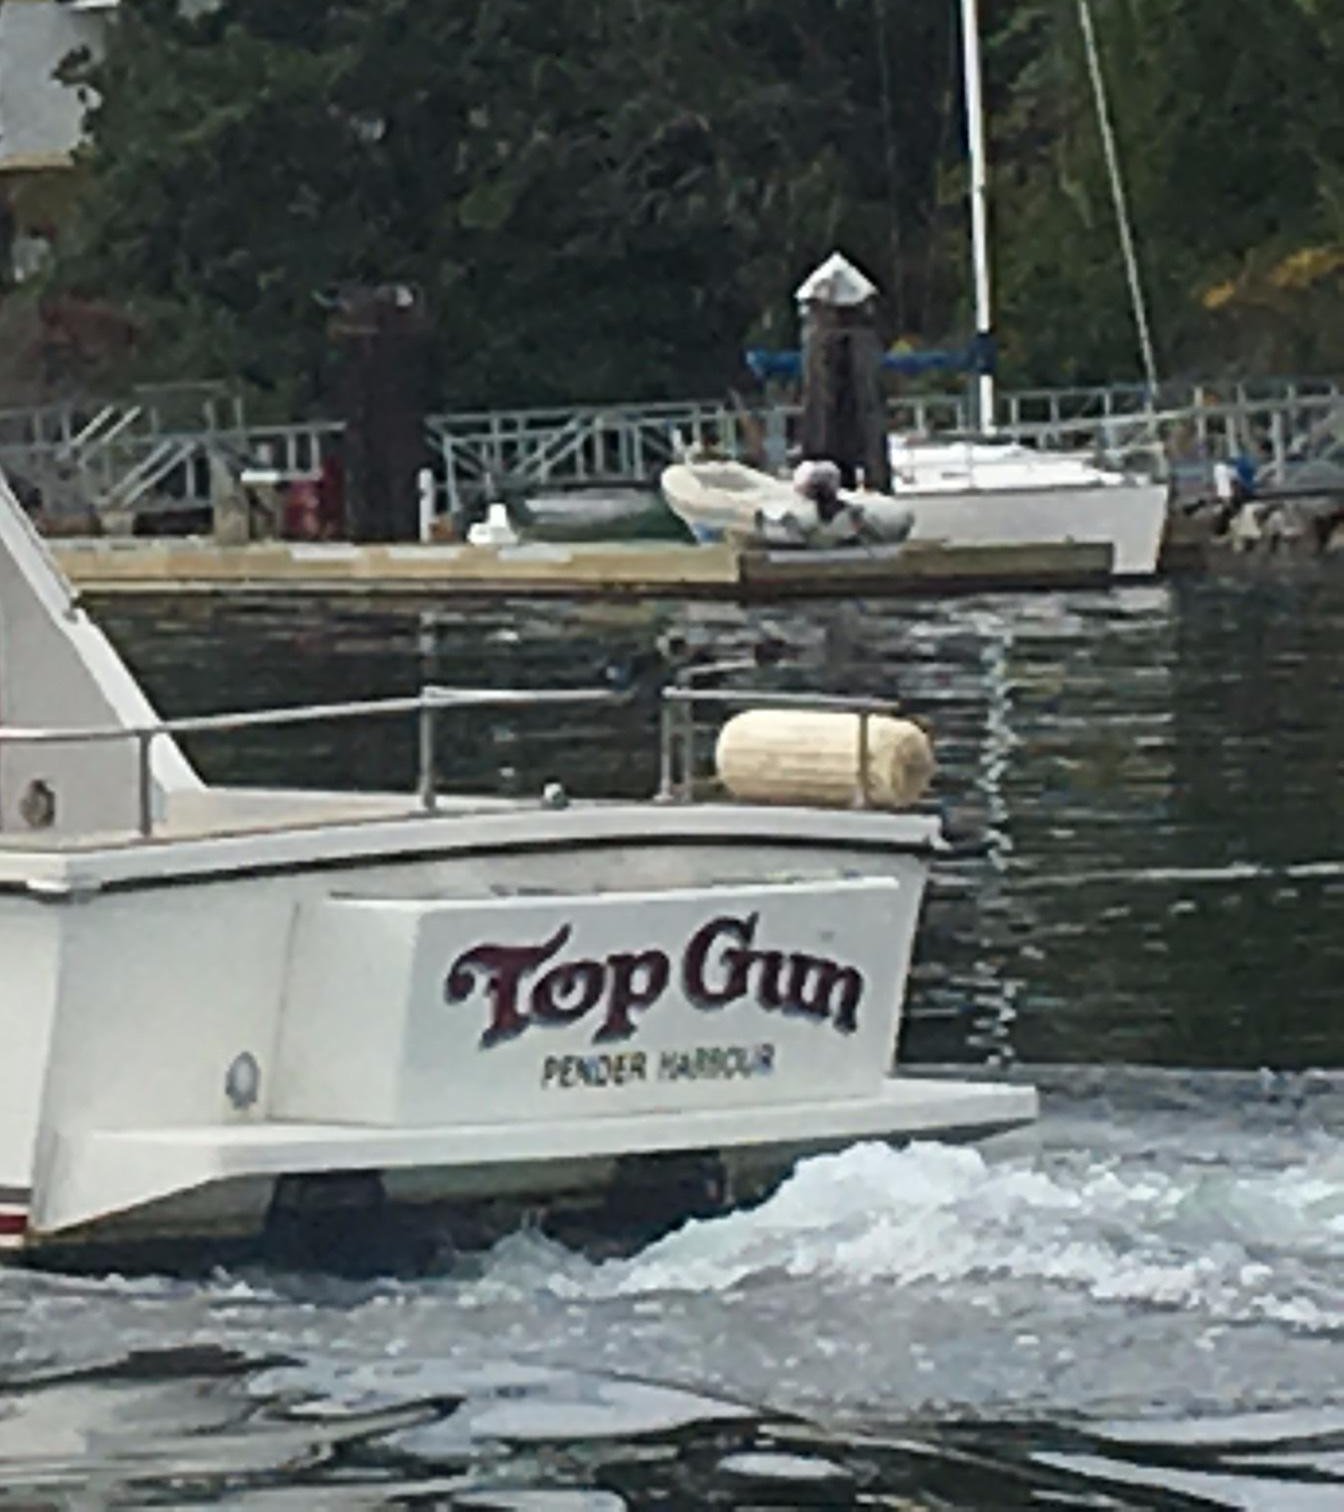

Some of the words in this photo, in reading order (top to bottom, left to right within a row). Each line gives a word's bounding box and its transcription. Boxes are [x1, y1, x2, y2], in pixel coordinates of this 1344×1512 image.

[443, 922, 670, 1050] Top
[682, 910, 863, 1035] Gun
[541, 1050, 647, 1090] PENDER
[658, 1042, 776, 1082] HARBOUR
